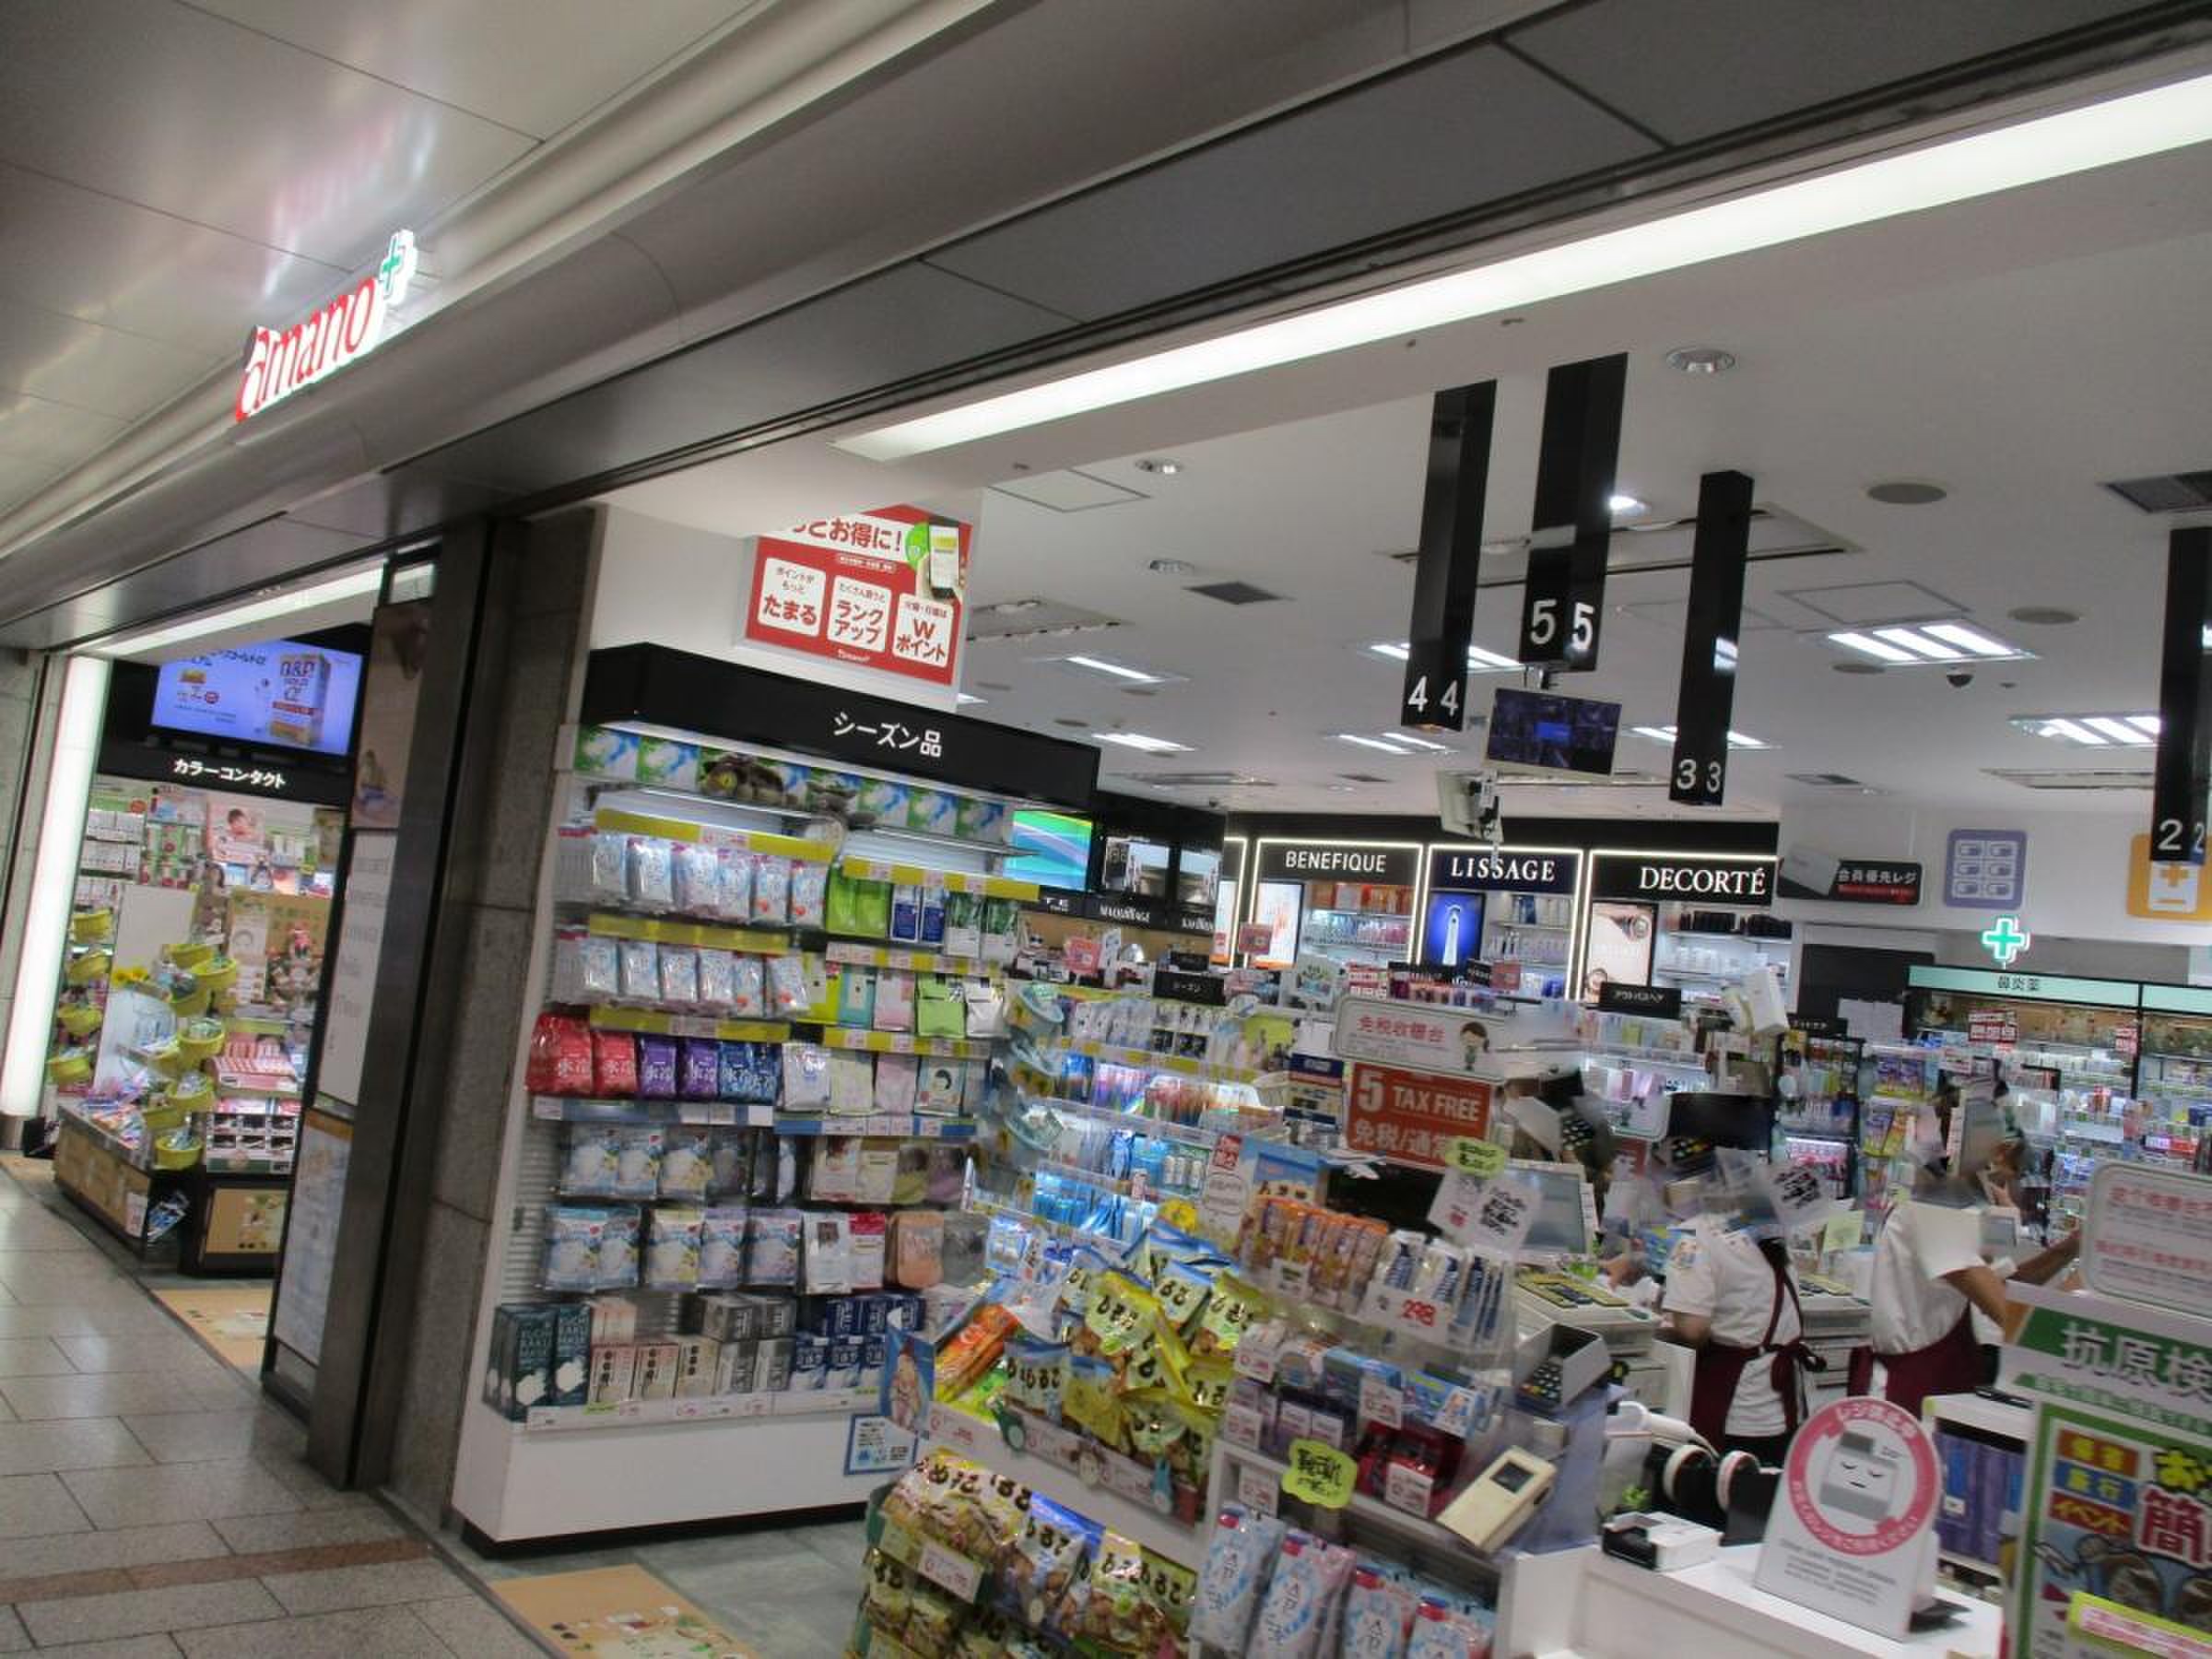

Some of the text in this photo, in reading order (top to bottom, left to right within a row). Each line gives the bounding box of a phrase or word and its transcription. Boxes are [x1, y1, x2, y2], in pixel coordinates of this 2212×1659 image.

[794, 518, 902, 552] とお得に!
[764, 594, 818, 626] たまる
[837, 600, 884, 625] ランク
[1530, 599, 1558, 644] 5
[834, 618, 882, 644] アップ
[913, 618, 935, 640] W
[1571, 603, 1595, 651] 5
[895, 634, 947, 662] ポイント
[1408, 676, 1429, 712] 4
[1441, 679, 1460, 715] 4
[832, 711, 943, 759] シーズン品
[174, 758, 287, 790] カラーコンタクト
[1677, 759, 1698, 790] 3
[1707, 761, 1723, 794] 3
[2158, 819, 2183, 851] 2
[1285, 850, 1387, 874] BENEFIQUE
[1452, 855, 1556, 882] LISSAGE
[1639, 865, 1766, 896] DECORTÉ
[1358, 1069, 1384, 1113] 5
[1391, 1086, 1481, 1123] TAX FREE
[2142, 1487, 2212, 1564] 簡
